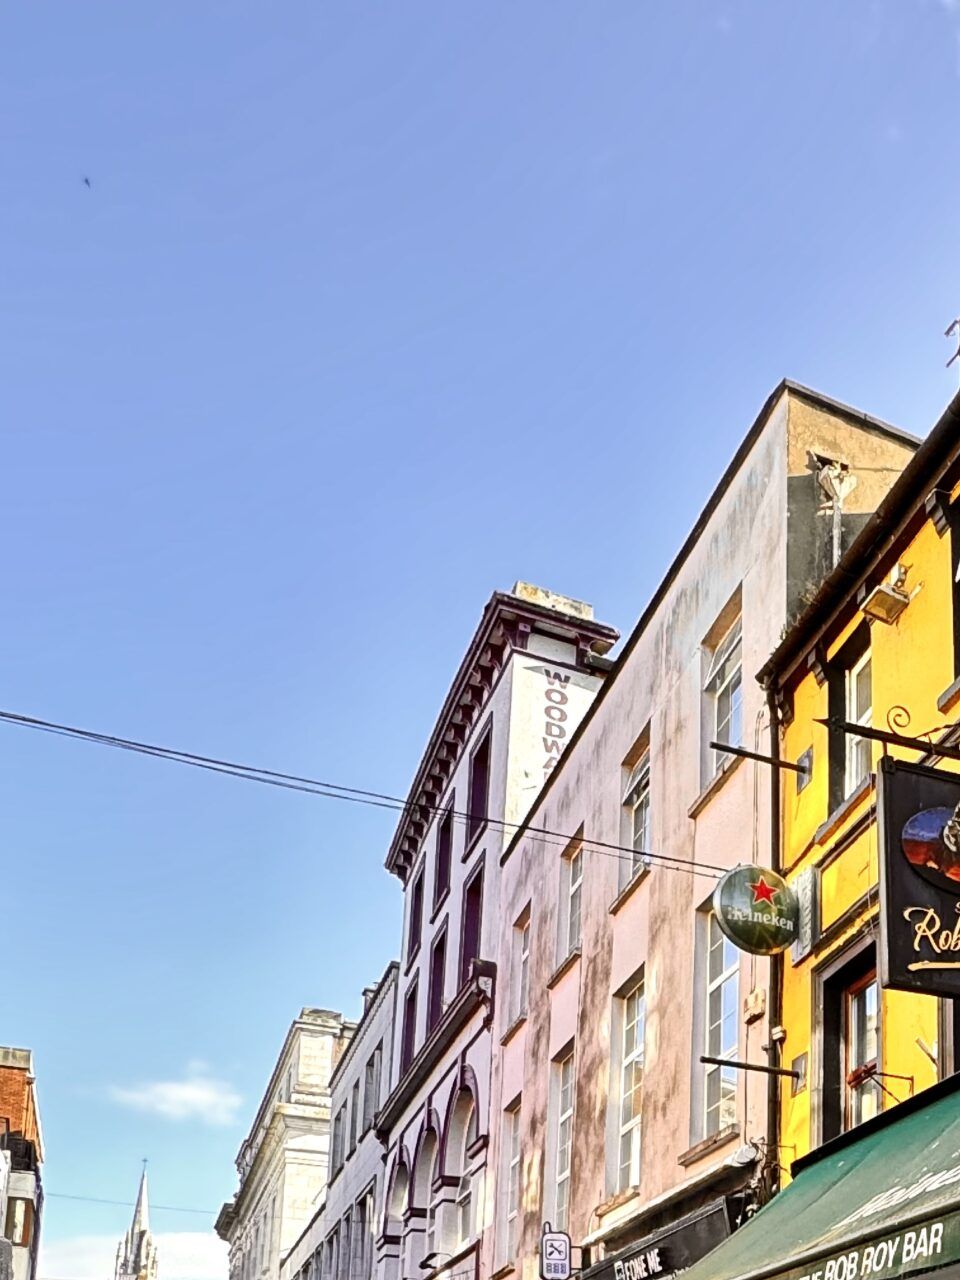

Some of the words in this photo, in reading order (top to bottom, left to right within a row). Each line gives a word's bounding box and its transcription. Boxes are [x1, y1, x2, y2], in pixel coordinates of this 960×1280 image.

[727, 906, 794, 931] Heineken
[646, 1248, 663, 1275] ME
[860, 1236, 900, 1276] ROY
[902, 1222, 944, 1264] BAR
